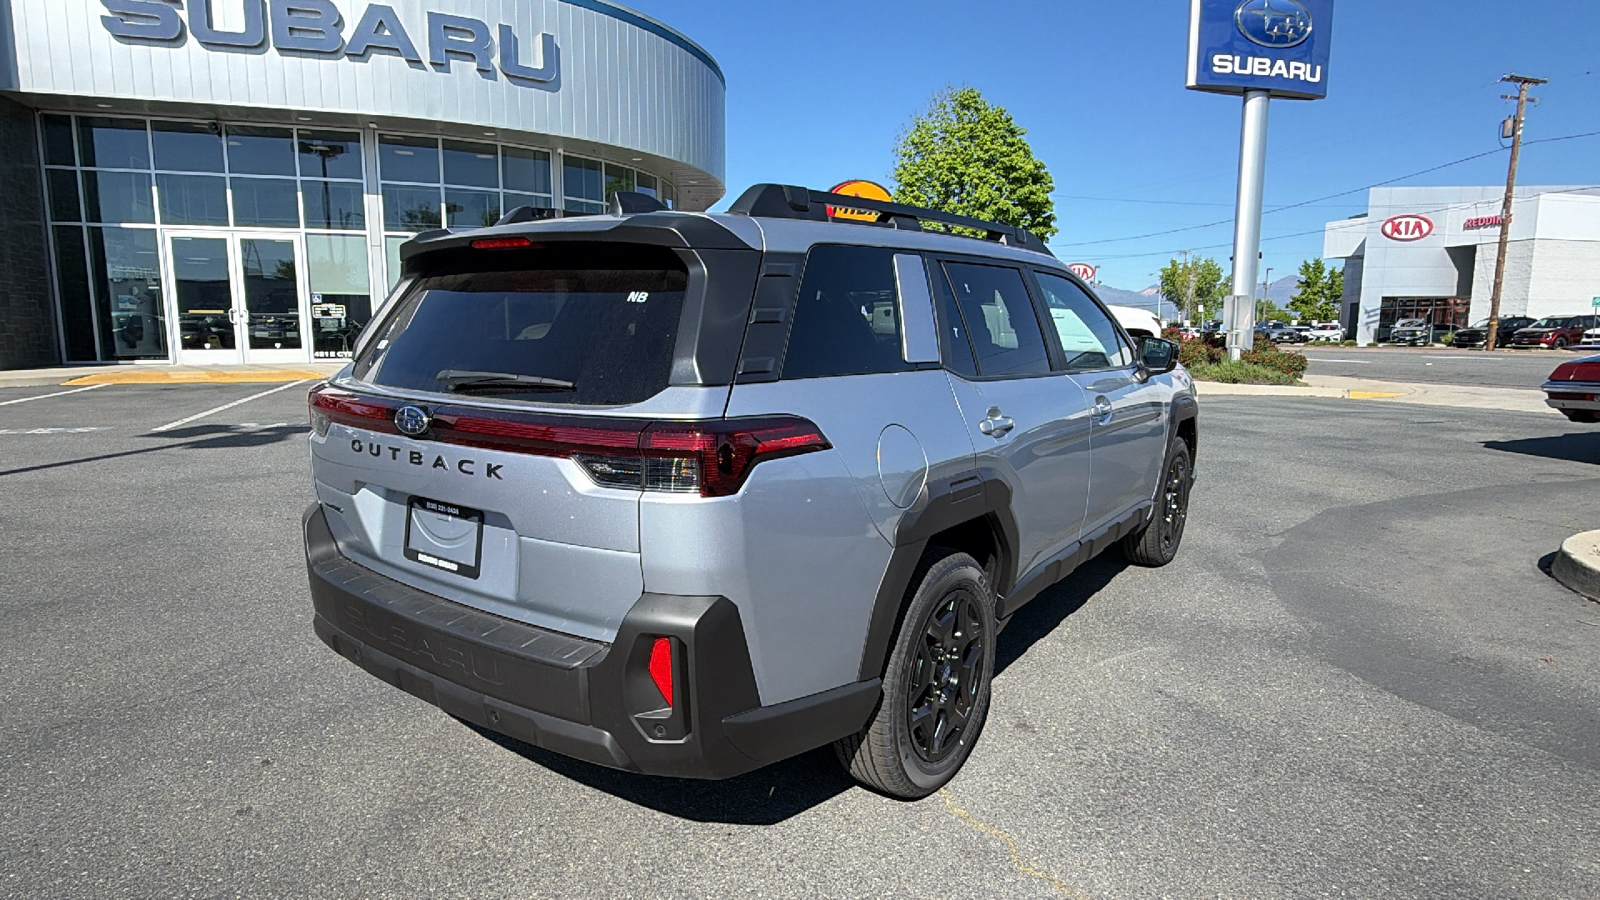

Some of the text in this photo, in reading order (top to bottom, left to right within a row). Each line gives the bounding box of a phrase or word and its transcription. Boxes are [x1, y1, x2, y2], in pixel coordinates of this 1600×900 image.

[99, 0, 558, 84] SUBARU
[1212, 54, 1321, 83] SUBARU
[1389, 220, 1424, 236] KIA
[626, 291, 649, 303] NB
[351, 439, 504, 480] OUTBACK
